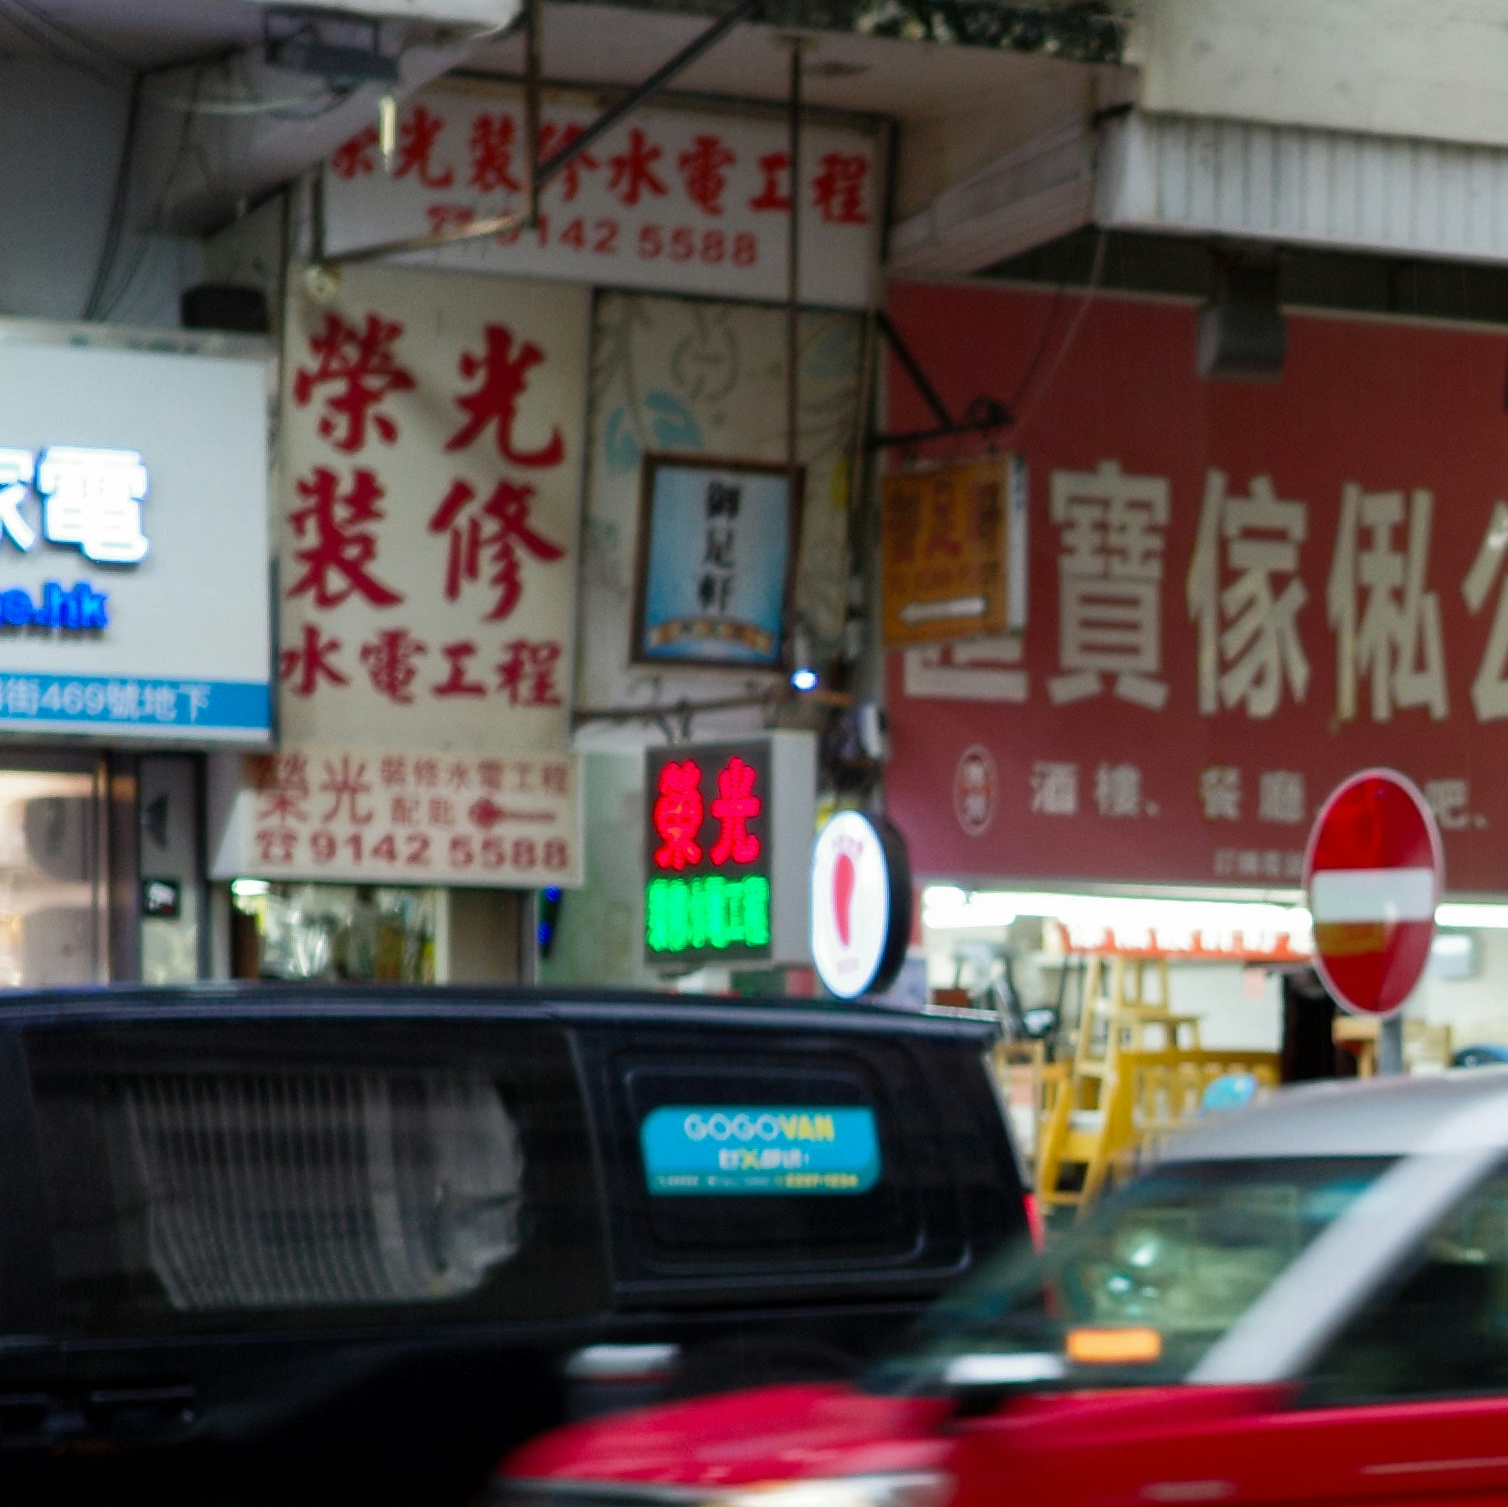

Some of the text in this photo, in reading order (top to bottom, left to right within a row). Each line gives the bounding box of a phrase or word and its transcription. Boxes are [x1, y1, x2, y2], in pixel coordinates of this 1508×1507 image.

[637, 223, 759, 270] 5588
[293, 312, 566, 469] 榮光
[285, 466, 566, 623] 裝修
[280, 623, 564, 710] 水電工程
[309, 830, 569, 871] 9142 5588
[683, 1112, 836, 1142] GOGOVAN
